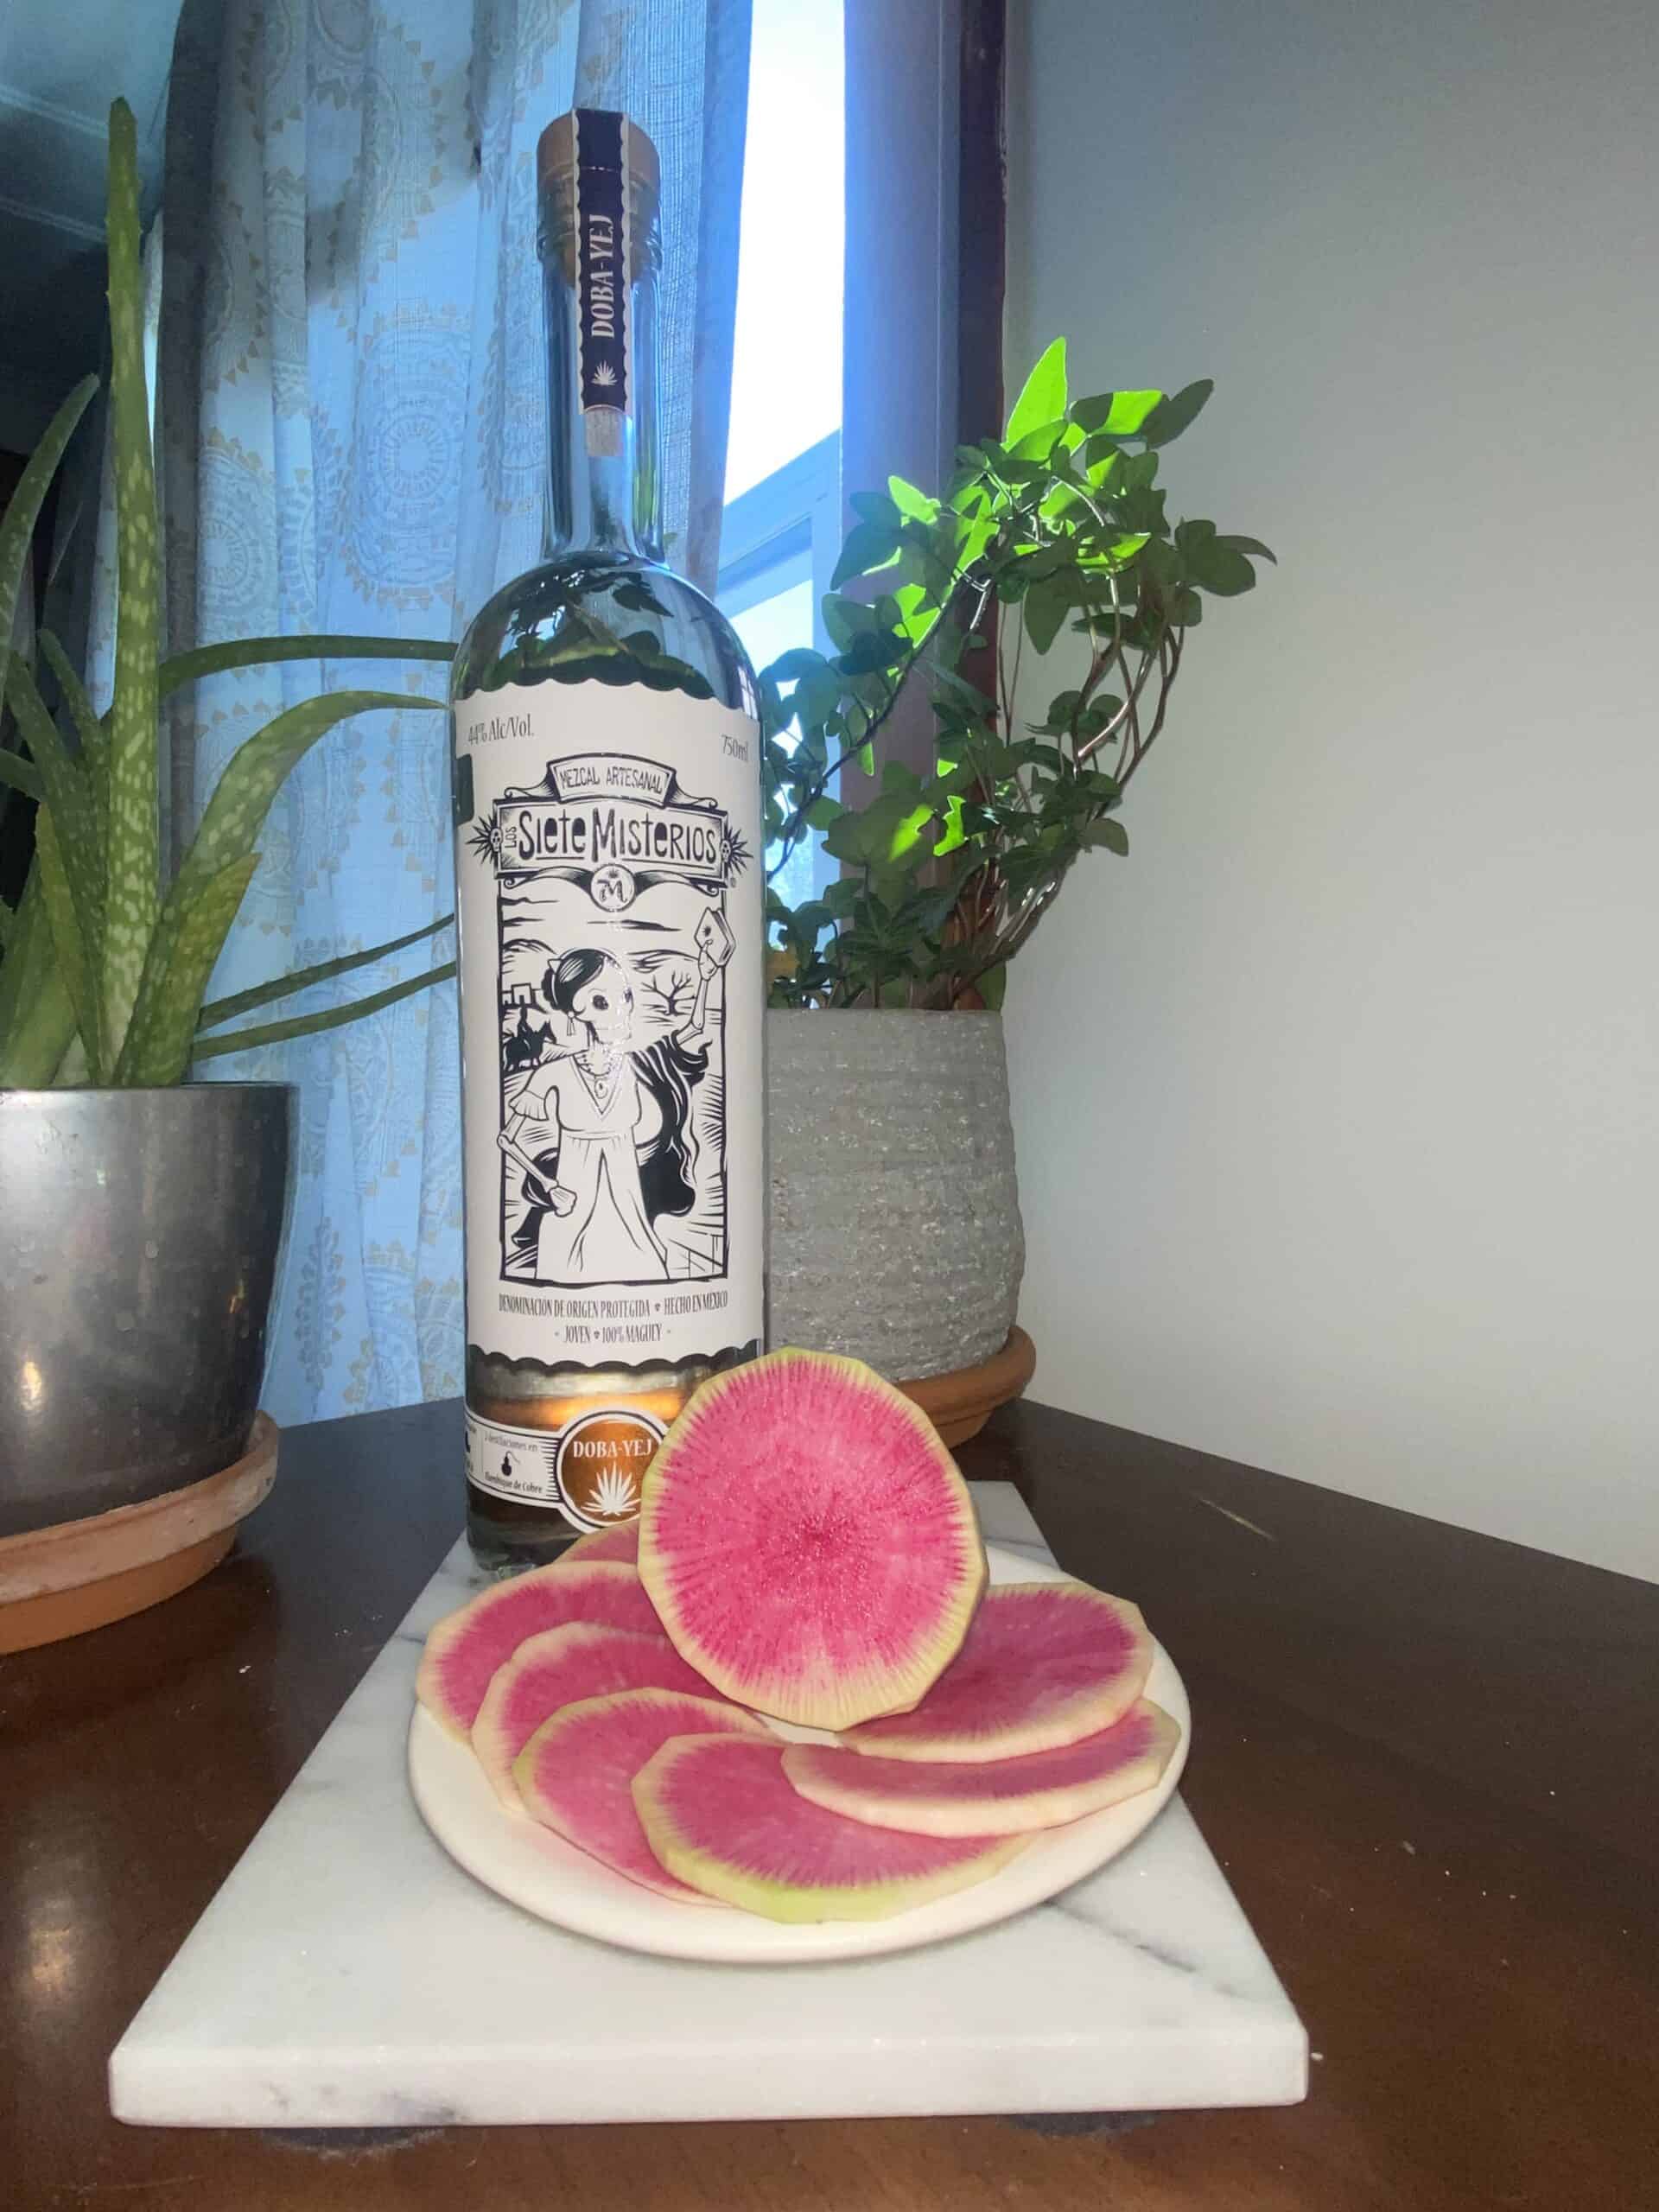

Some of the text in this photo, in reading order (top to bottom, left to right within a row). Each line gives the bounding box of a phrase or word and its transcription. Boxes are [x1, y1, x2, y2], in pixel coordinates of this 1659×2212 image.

[589, 214, 614, 338] DOBA-YEJ
[721, 734, 749, 762] 750ml
[560, 766, 663, 794] MEZCAL ARTESANAL
[504, 826, 518, 849] LOS
[554, 1299, 566, 1318] DE
[566, 1300, 599, 1319] ORIGEN
[601, 1299, 651, 1319] PROTEGIDA
[664, 1296, 692, 1315] HECHO
[691, 1294, 702, 1313] EN
[564, 1323, 662, 1344] JOVEN 100% MAGUEY
[573, 1439, 652, 1459] DOBA-YEJ
